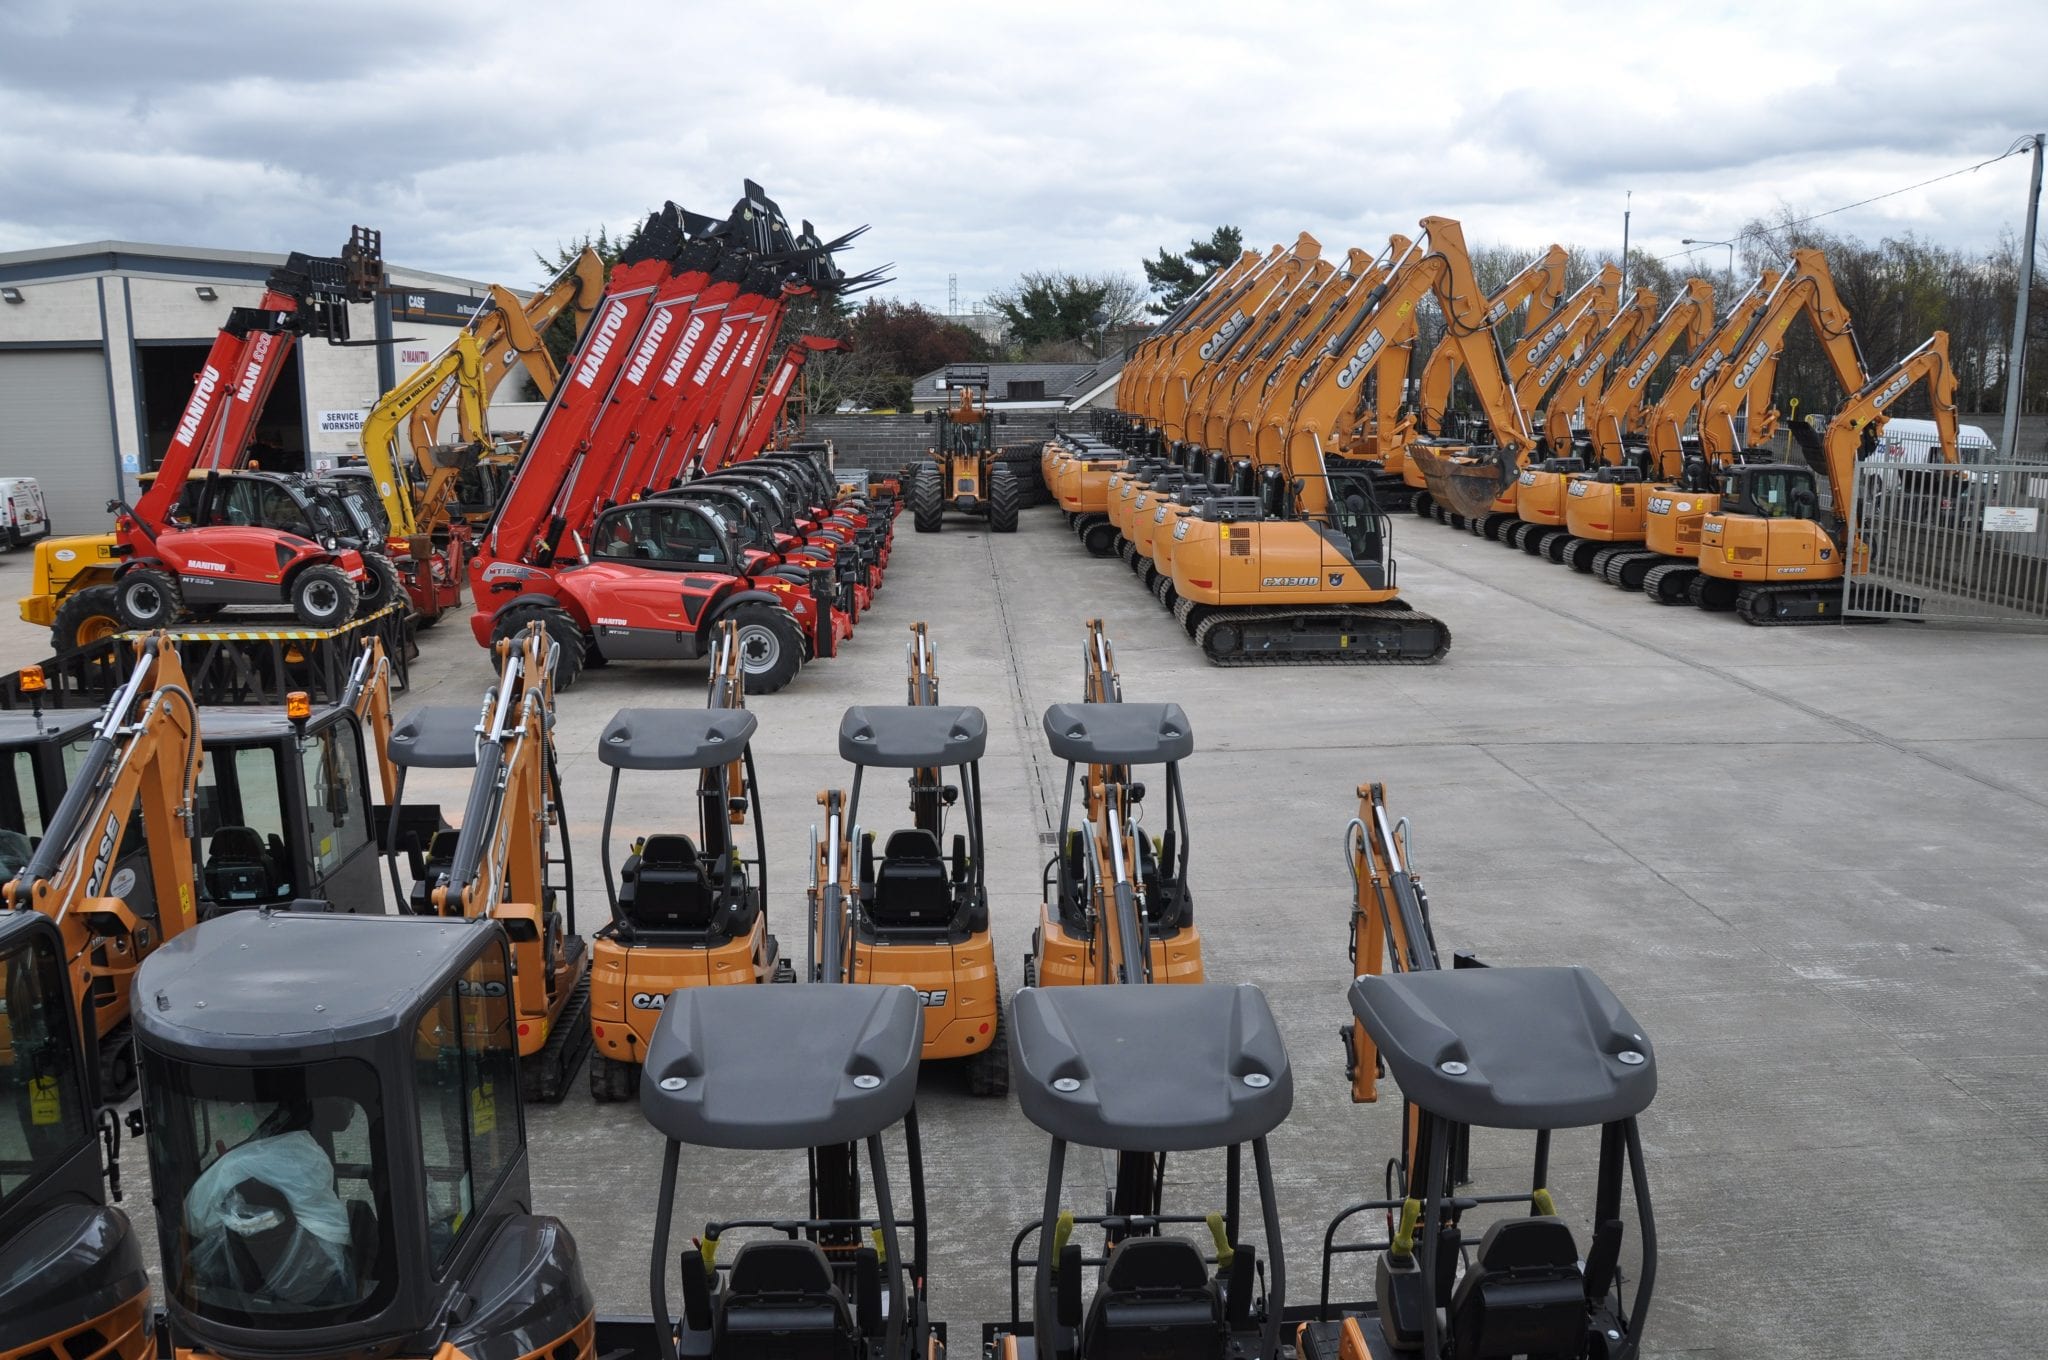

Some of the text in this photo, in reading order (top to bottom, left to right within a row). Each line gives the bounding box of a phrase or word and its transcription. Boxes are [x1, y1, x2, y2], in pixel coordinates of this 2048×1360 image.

[408, 295, 425, 309] CASE
[577, 300, 628, 389] MANITOU
[627, 308, 673, 386] MANITOU
[662, 316, 705, 387] MANITOU
[1199, 308, 1247, 361] CASE
[1527, 322, 1566, 363] CASE
[693, 323, 733, 387] MANITOU
[1336, 327, 1386, 389] CASE
[1538, 354, 1564, 387] CASE
[1578, 352, 1606, 387] CASE
[1628, 351, 1658, 389] CASE
[1690, 349, 1724, 391] CASE
[1734, 340, 1769, 389] CASE
[237, 362, 262, 403] MANI
[411, 377, 435, 398] HOLLAND
[431, 373, 457, 414] CASE
[1873, 373, 1910, 408] CASE
[176, 365, 220, 447] MANITOU
[327, 413, 359, 421] SERVICE
[1648, 497, 1672, 515] ASE
[188, 560, 226, 572] MANITOU
[1262, 576, 1320, 588] CX130D
[597, 617, 628, 626] MANITOU
[86, 811, 120, 898] CASE
[632, 992, 668, 1010] CA
[918, 989, 947, 1007] SE
